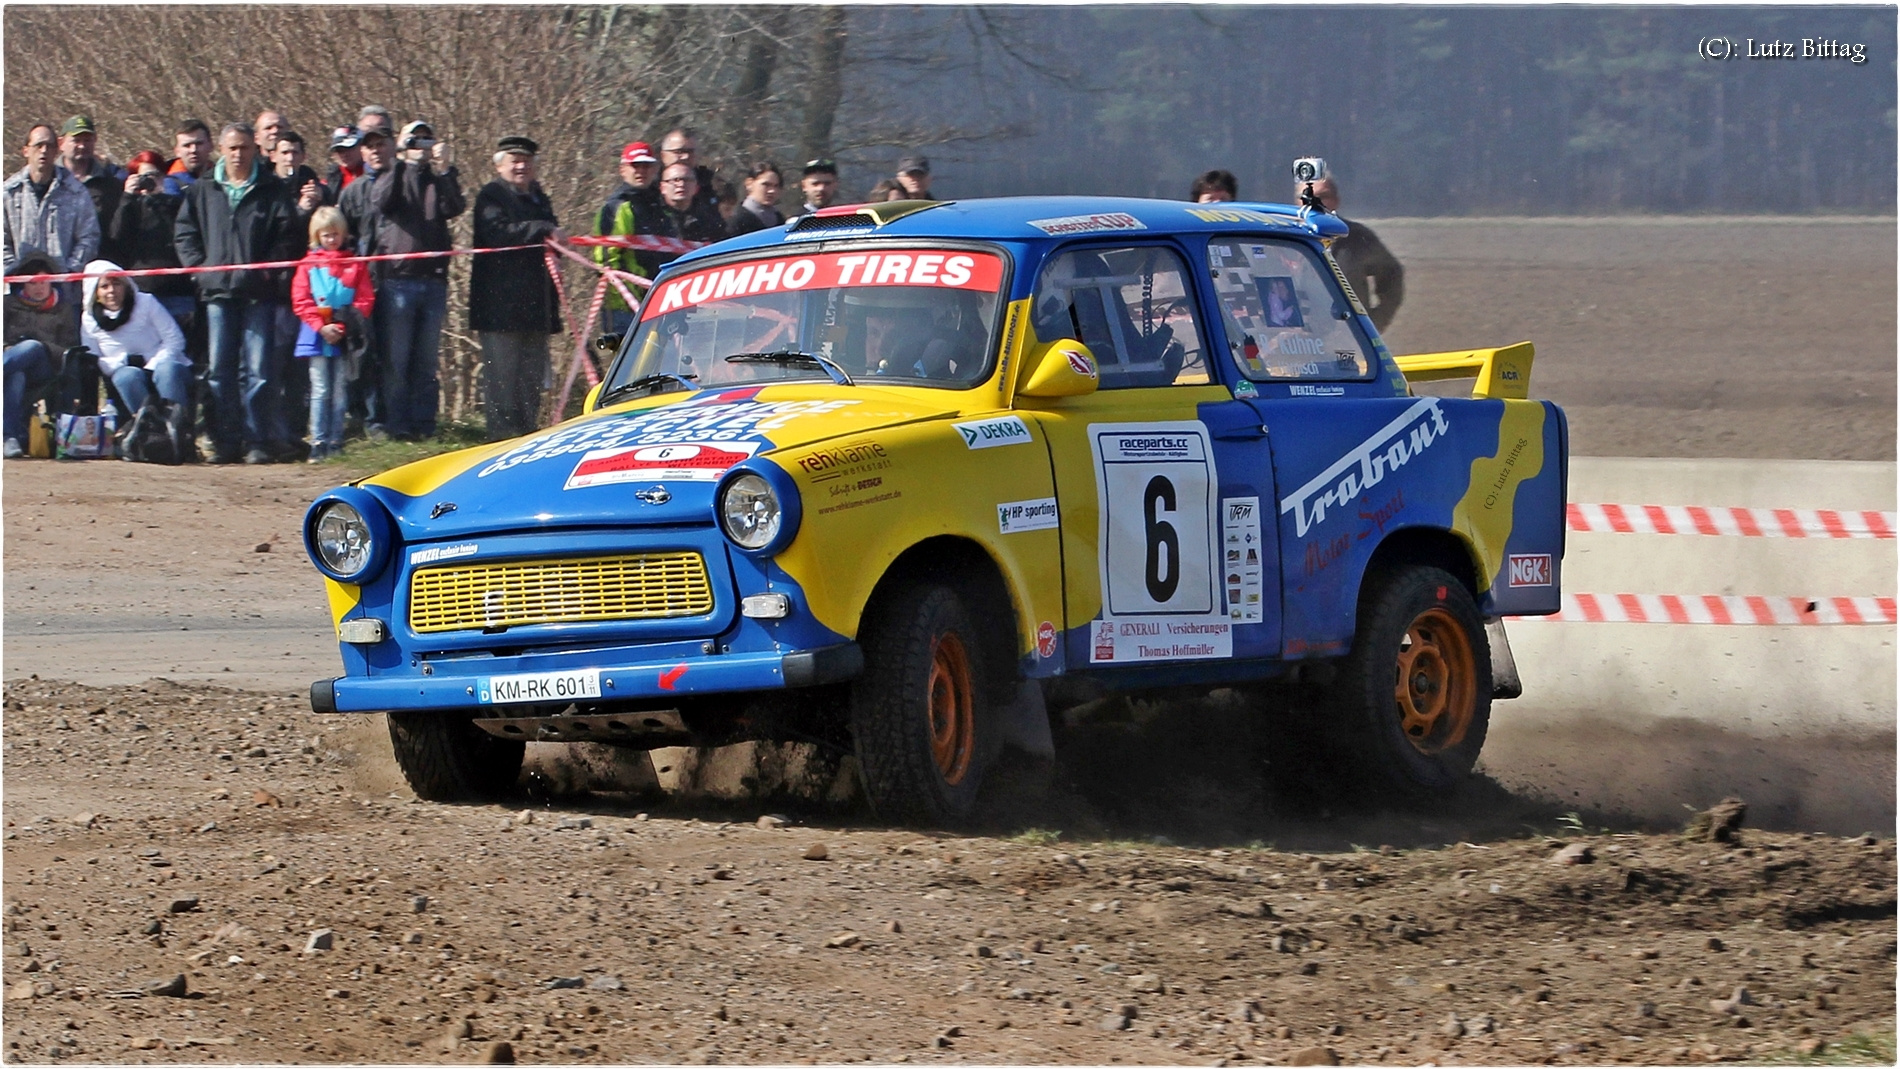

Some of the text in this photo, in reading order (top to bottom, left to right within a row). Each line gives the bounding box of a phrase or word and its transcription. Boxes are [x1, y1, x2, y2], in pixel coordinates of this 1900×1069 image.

[658, 254, 975, 313] KUMHO TIRES
[978, 421, 1027, 439] DEKRA
[477, 428, 771, 478] 035954/52367
[658, 447, 674, 458] 6
[1119, 437, 1188, 451] raceparts.cc
[797, 442, 887, 474] rehklame
[842, 459, 893, 476] werkstatt
[1281, 397, 1450, 538] Trabant
[1012, 503, 1056, 520] HP sporting
[1144, 475, 1180, 603] 6
[410, 547, 440, 566] WENZEL
[1511, 558, 1544, 584] NGK
[1120, 622, 1229, 637] GENERALI Versicherungen
[1138, 643, 1214, 658] Thomas Hoffmüller
[481, 677, 586, 701] D KM-RK 601
